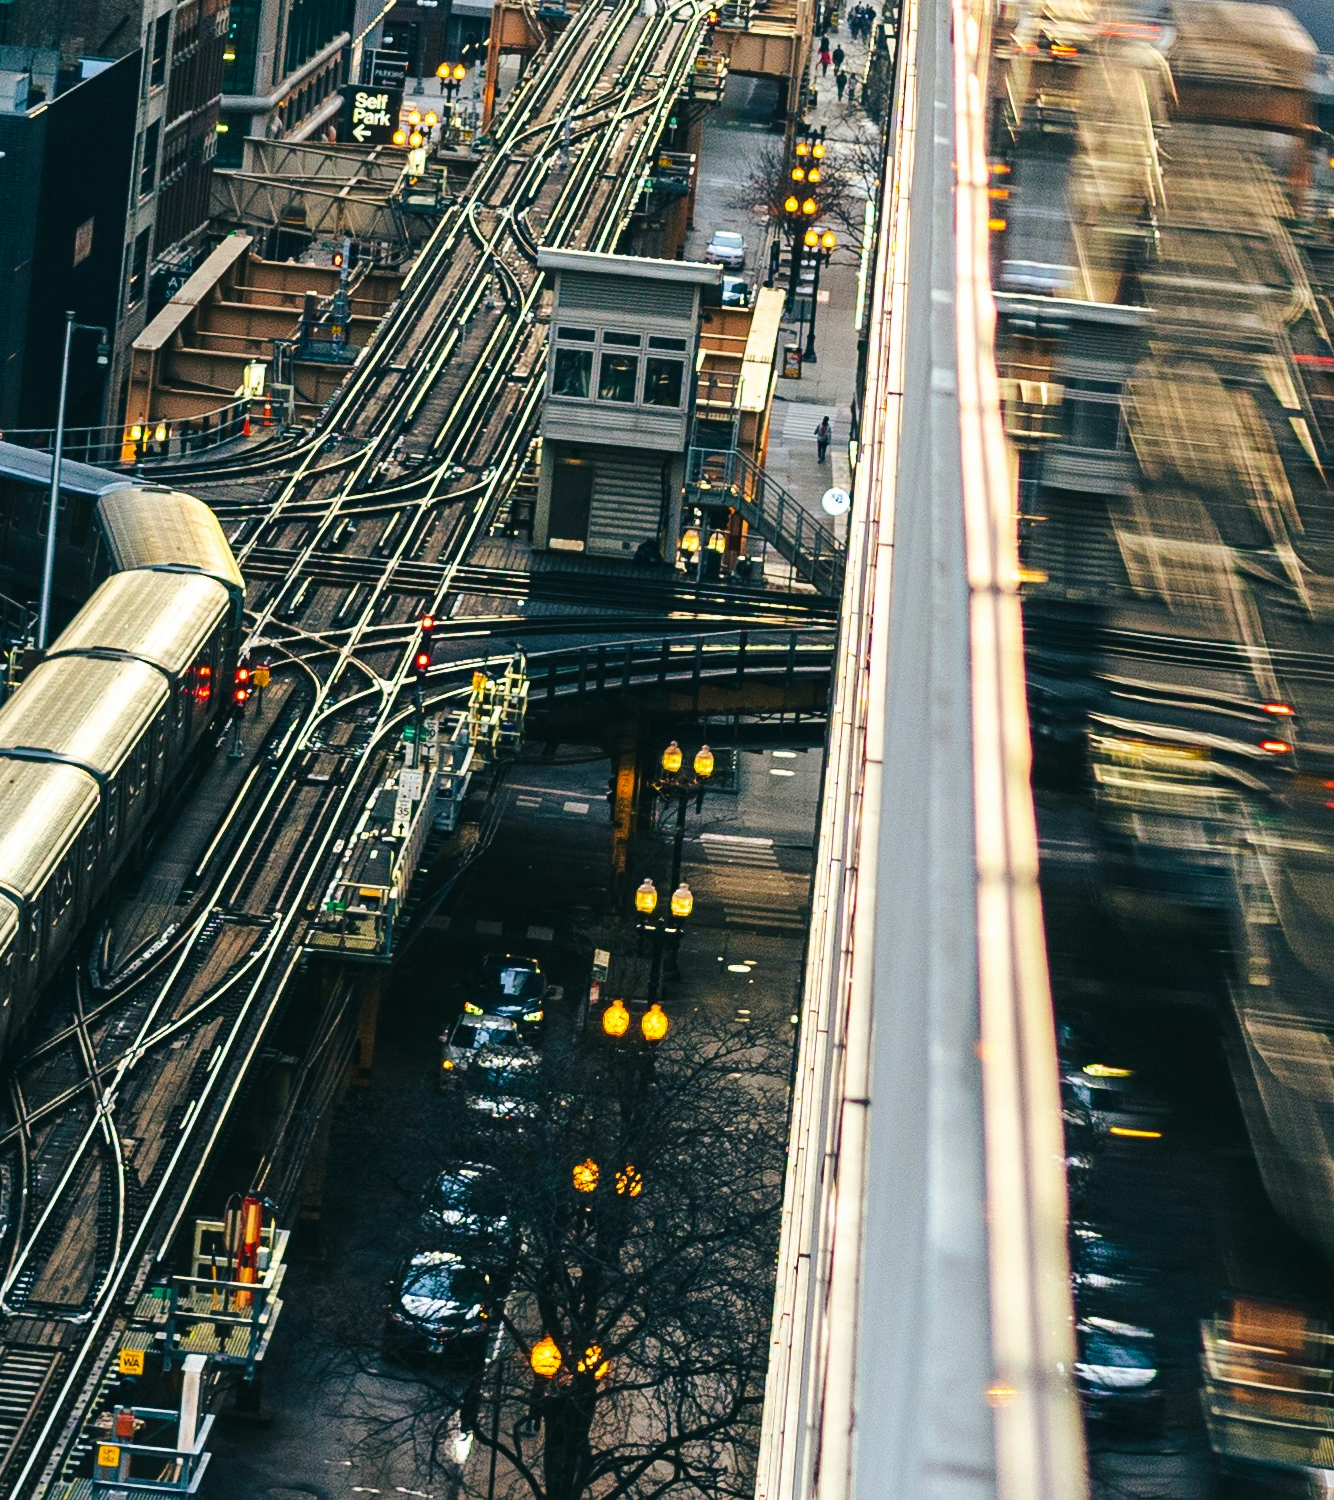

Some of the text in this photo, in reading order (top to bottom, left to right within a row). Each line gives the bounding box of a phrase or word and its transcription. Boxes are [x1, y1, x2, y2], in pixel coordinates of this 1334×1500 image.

[355, 91, 389, 110] Self
[353, 107, 391, 127] Park
[396, 807, 410, 817] 35
[123, 1358, 140, 1369] WA
